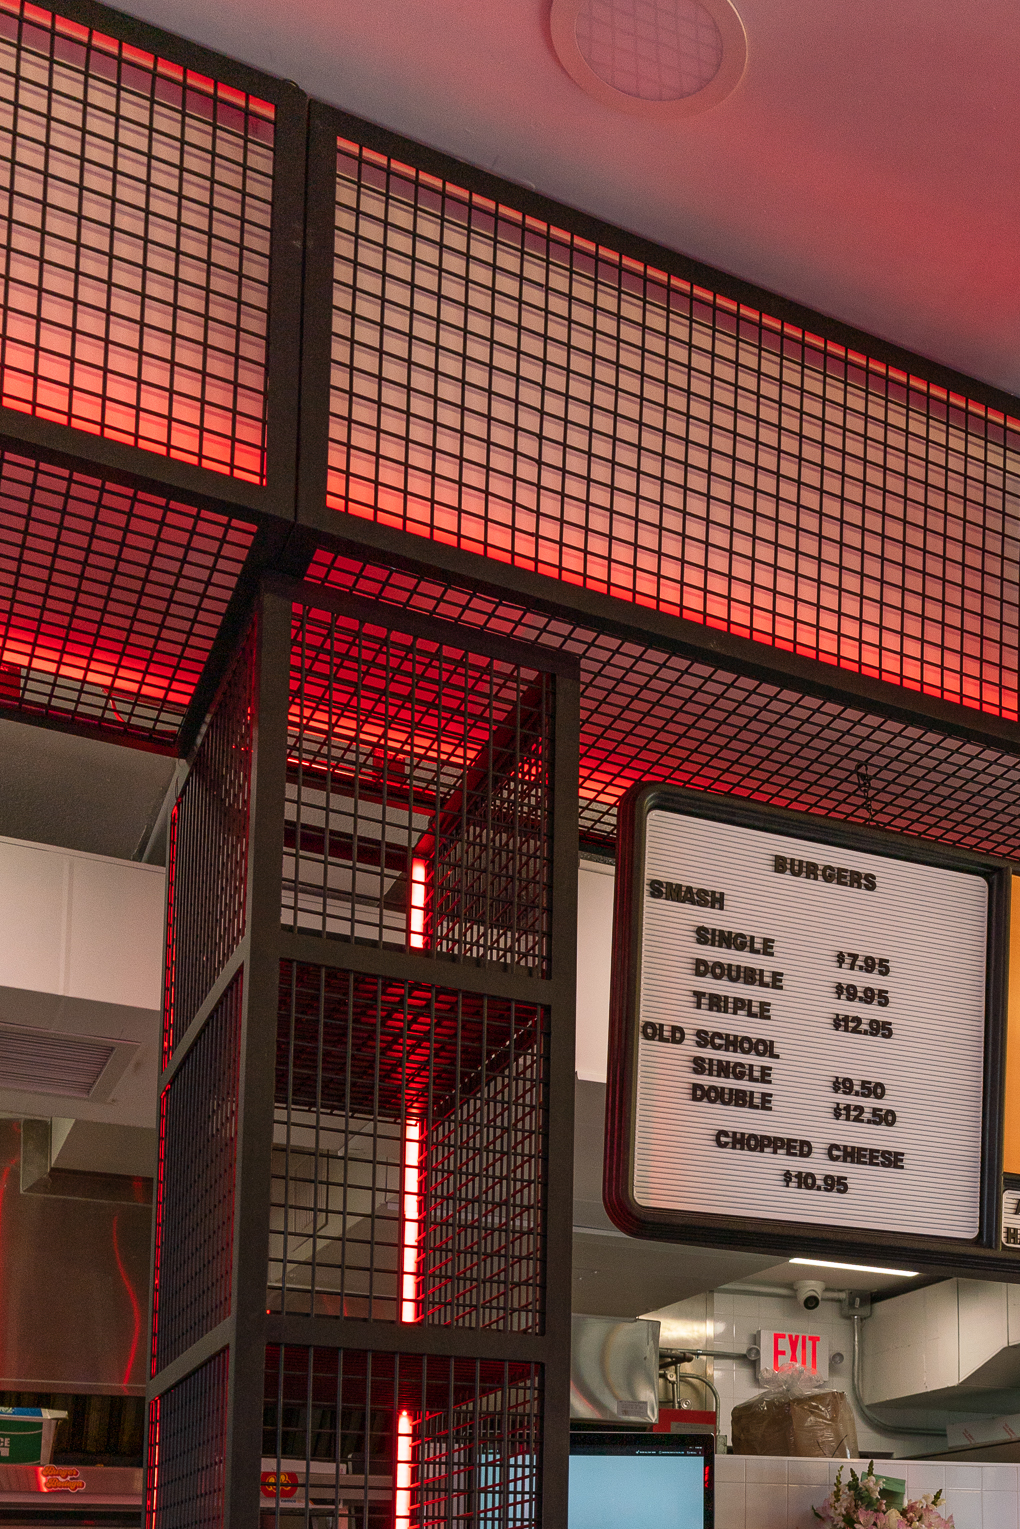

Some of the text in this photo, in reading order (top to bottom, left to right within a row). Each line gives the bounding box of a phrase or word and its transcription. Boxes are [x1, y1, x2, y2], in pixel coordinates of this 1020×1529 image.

[774, 854, 876, 891] BURGERS
[650, 879, 724, 909] SMASH
[695, 925, 890, 975] SINGLE $7.95
[694, 957, 890, 1006] DOUBLE $9.95
[693, 990, 893, 1037] TRIPLE $12.95
[642, 1021, 779, 1058] OLD SCHOOL
[692, 1056, 886, 1098] SINGLE $9.50
[691, 1083, 896, 1126] DOUBLE $12.50
[715, 1129, 904, 1169] CHOPPED CHEESE
[782, 1169, 848, 1193] $10.95
[773, 1332, 821, 1375] EXIT
